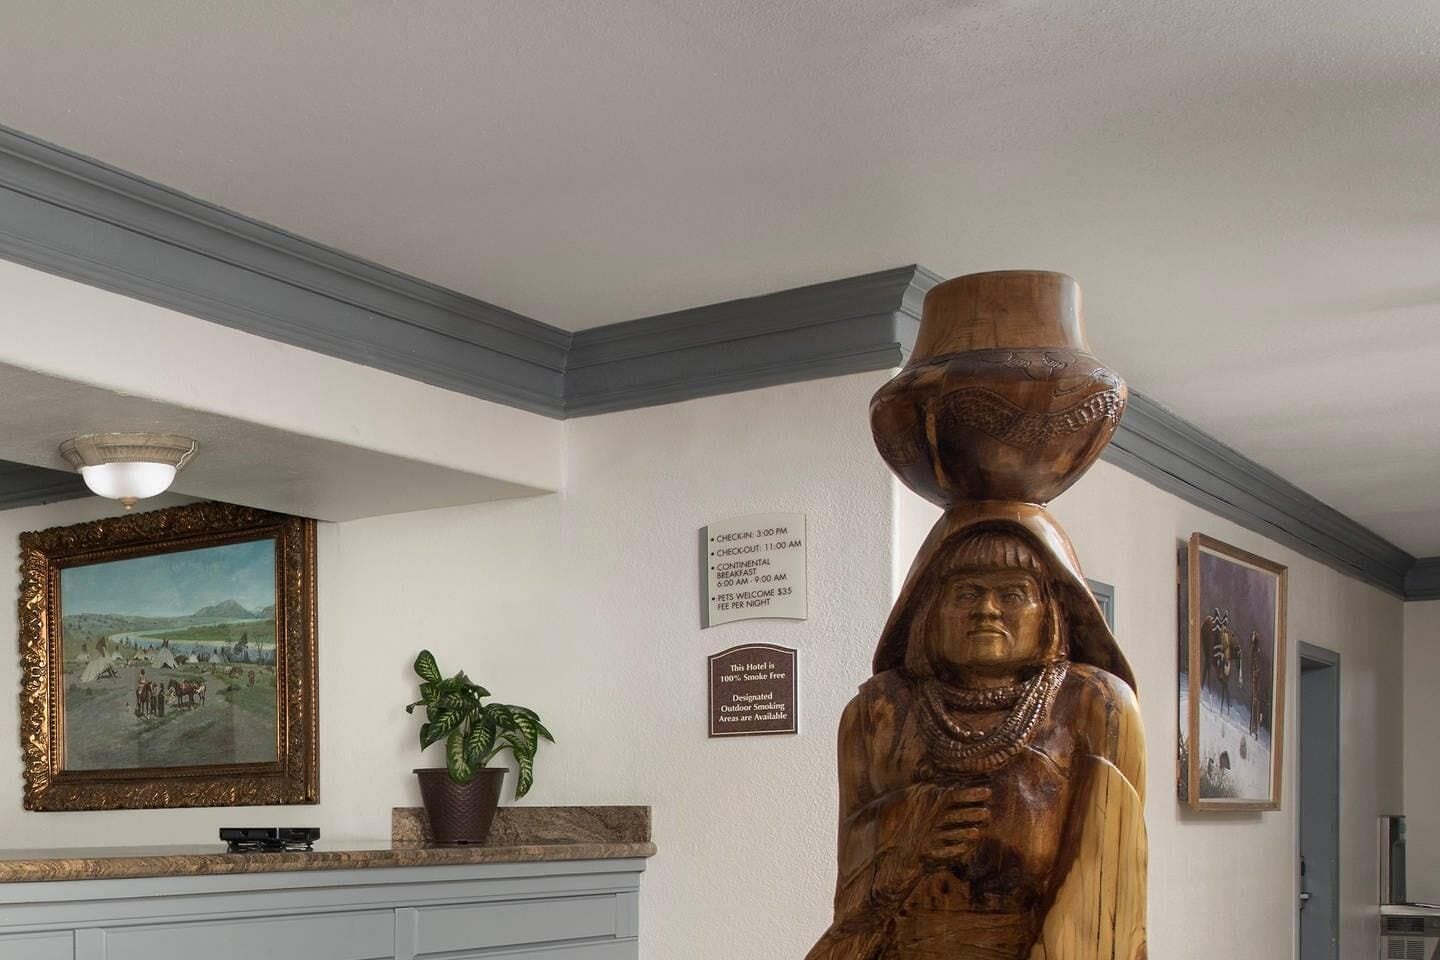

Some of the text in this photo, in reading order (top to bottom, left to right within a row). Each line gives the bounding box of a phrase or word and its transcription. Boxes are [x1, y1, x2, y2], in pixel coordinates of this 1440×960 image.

[756, 528, 774, 538] 3:00
[776, 527, 788, 535] PM
[764, 542, 787, 551] 11:00
[788, 540, 802, 548] AM
[716, 559, 771, 571] CONTINENTAL
[716, 568, 757, 580] BREAKFAST
[716, 579, 734, 588] 6:00
[736, 578, 748, 586] AM
[754, 575, 772, 584] 9:00
[718, 586, 792, 602] PETS WELCOME $35
[718, 598, 770, 611] FEE PER NIGHT
[730, 662, 775, 672] This Hotel is
[720, 672, 786, 682] 100% Smoke Free
[732, 692, 773, 703] Designated
[720, 702, 785, 712] Outdoor Smoking
[754, 712, 788, 720] Available
